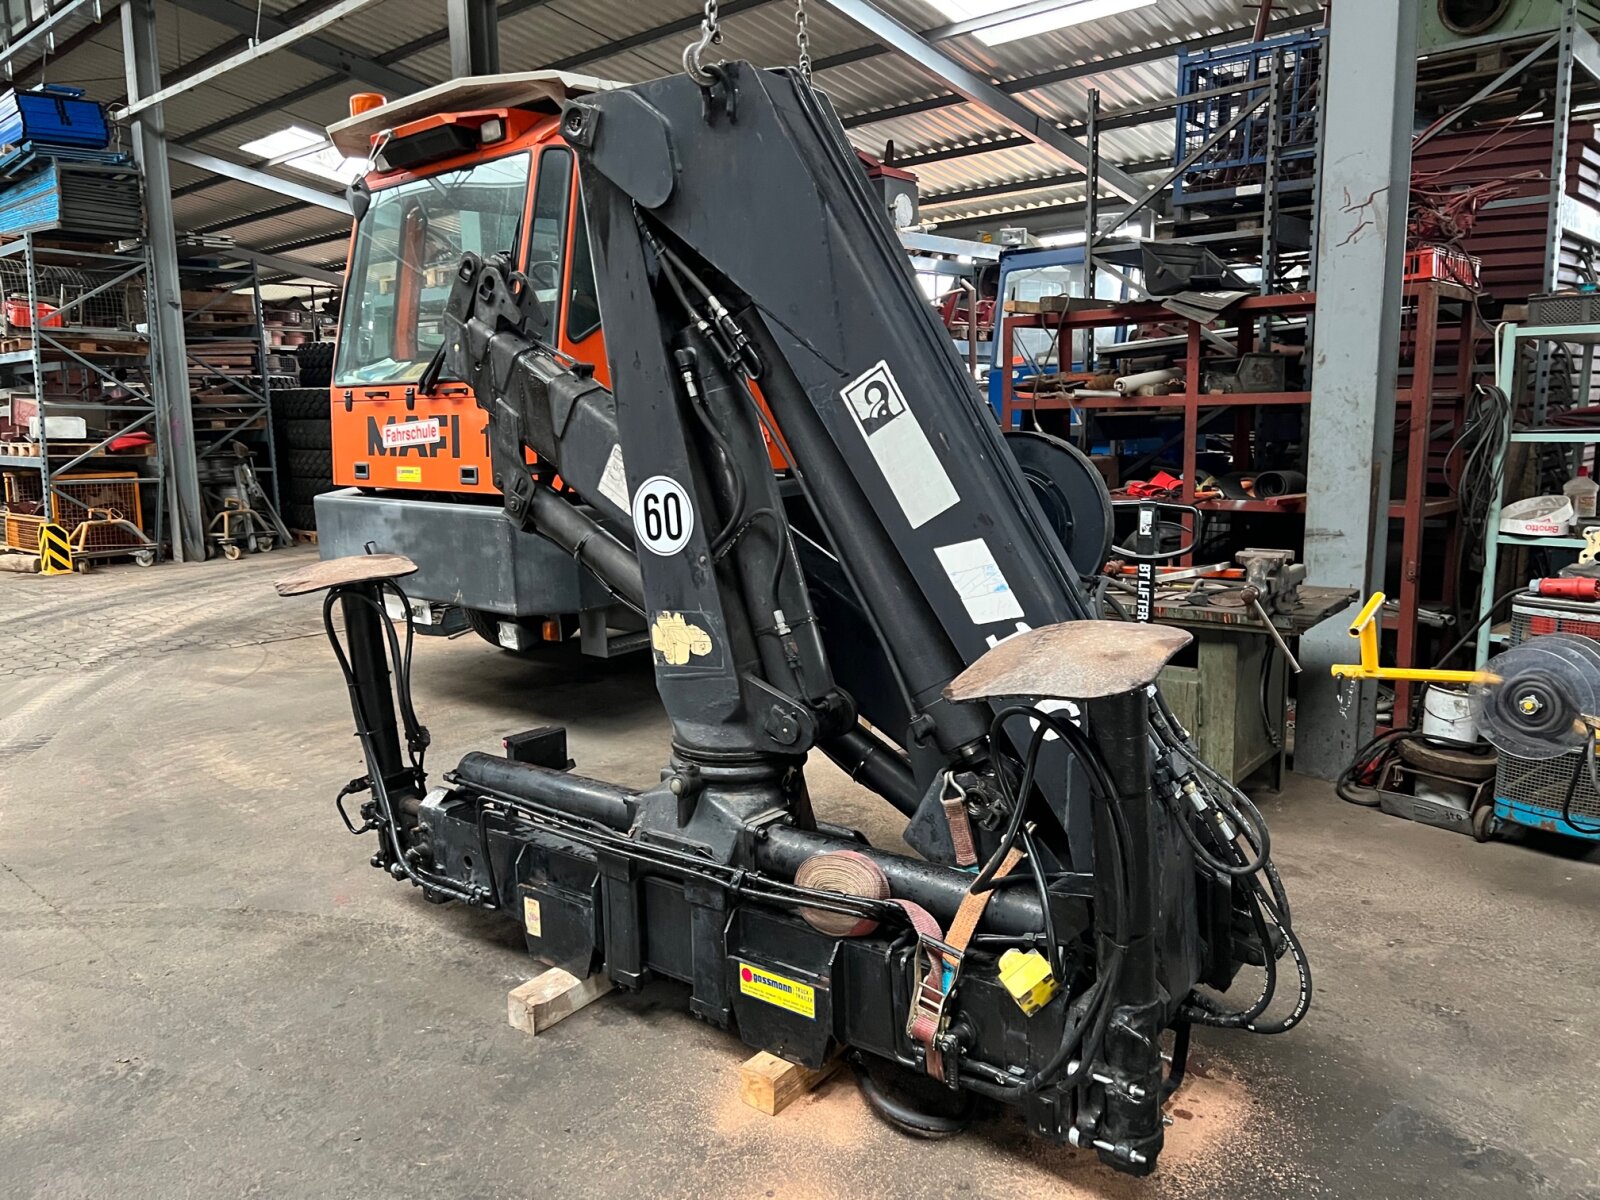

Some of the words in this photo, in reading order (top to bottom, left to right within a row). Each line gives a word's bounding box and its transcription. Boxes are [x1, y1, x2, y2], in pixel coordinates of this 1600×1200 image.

[385, 424, 437, 443] Fahrschule
[643, 492, 683, 541] 60
[1525, 523, 1559, 533] Binotto
[1139, 564, 1151, 579] BT
[1137, 581, 1150, 620] LIFTER
